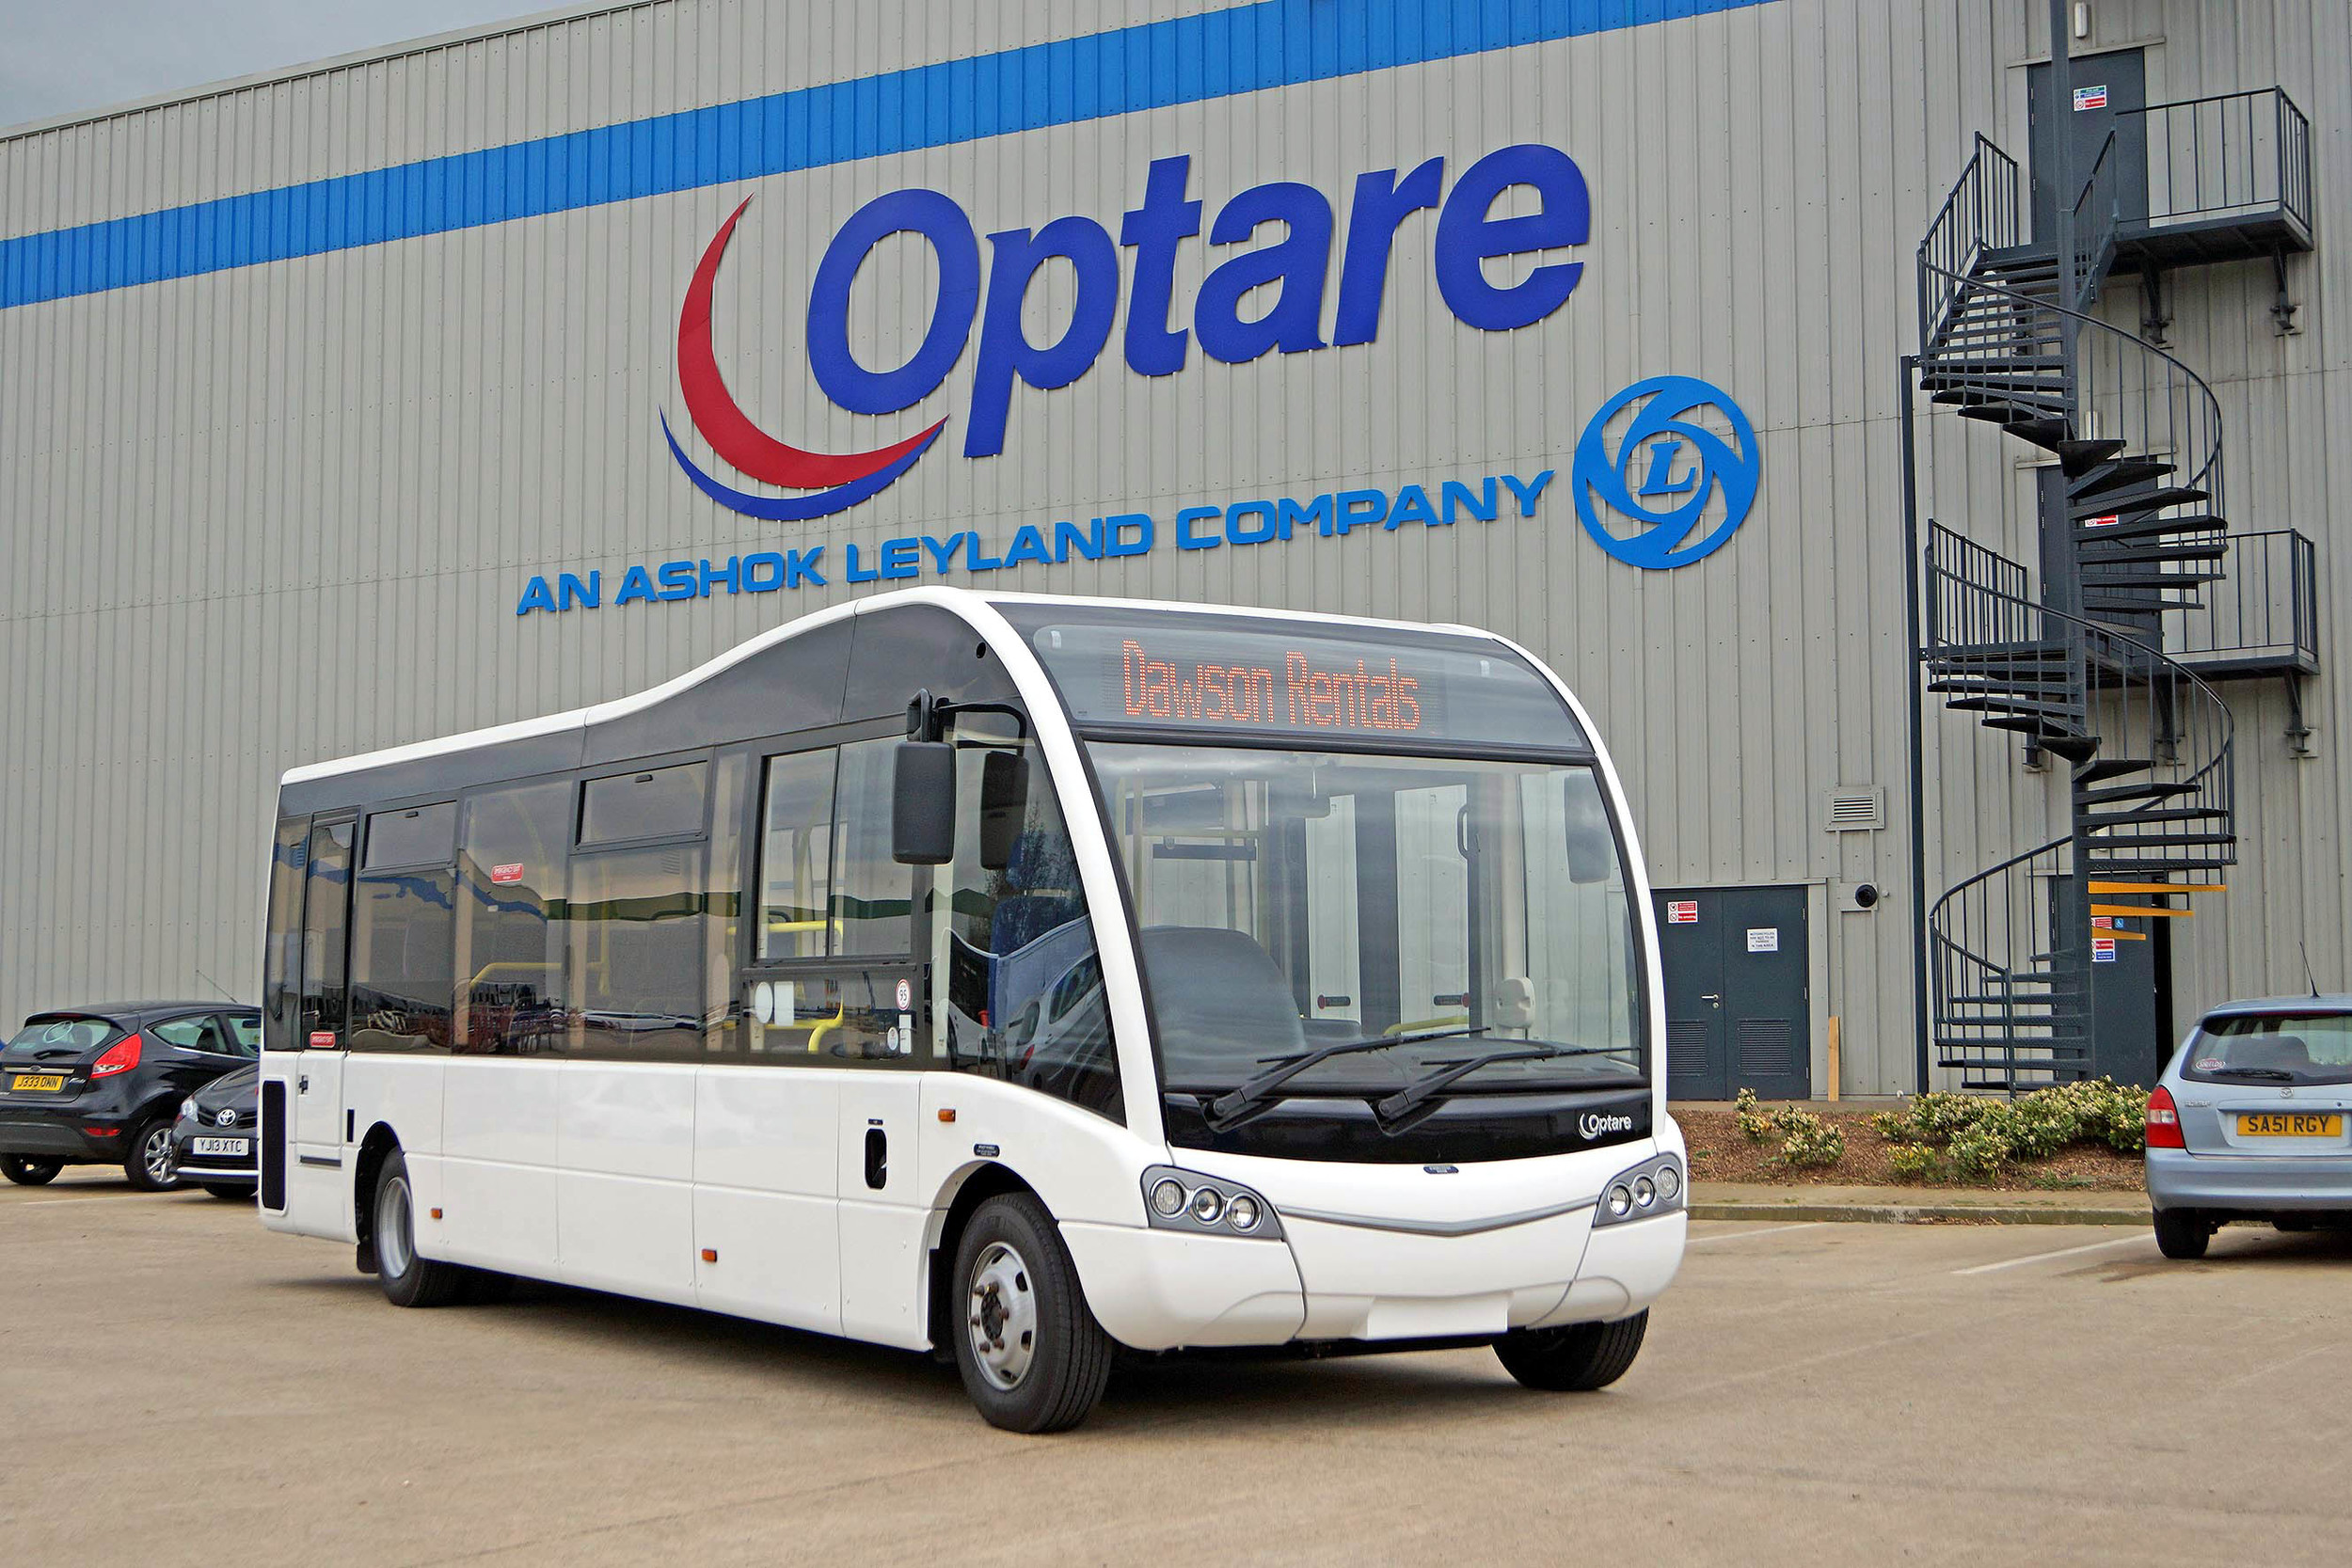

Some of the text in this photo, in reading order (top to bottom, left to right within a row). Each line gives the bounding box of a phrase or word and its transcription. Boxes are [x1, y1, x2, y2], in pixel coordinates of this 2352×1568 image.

[807, 143, 1591, 458] Optare
[516, 469, 1556, 615] AN ASHOK LEYLAND COMPANY
[1122, 639, 1421, 731] Dawson Rentals
[899, 989, 907, 1002] 95
[18, 1076, 40, 1087] J333
[1588, 1114, 1632, 1137] Optare
[2248, 1116, 2329, 1132] SA51 RGY
[200, 1139, 242, 1152] YJ13 XTC
